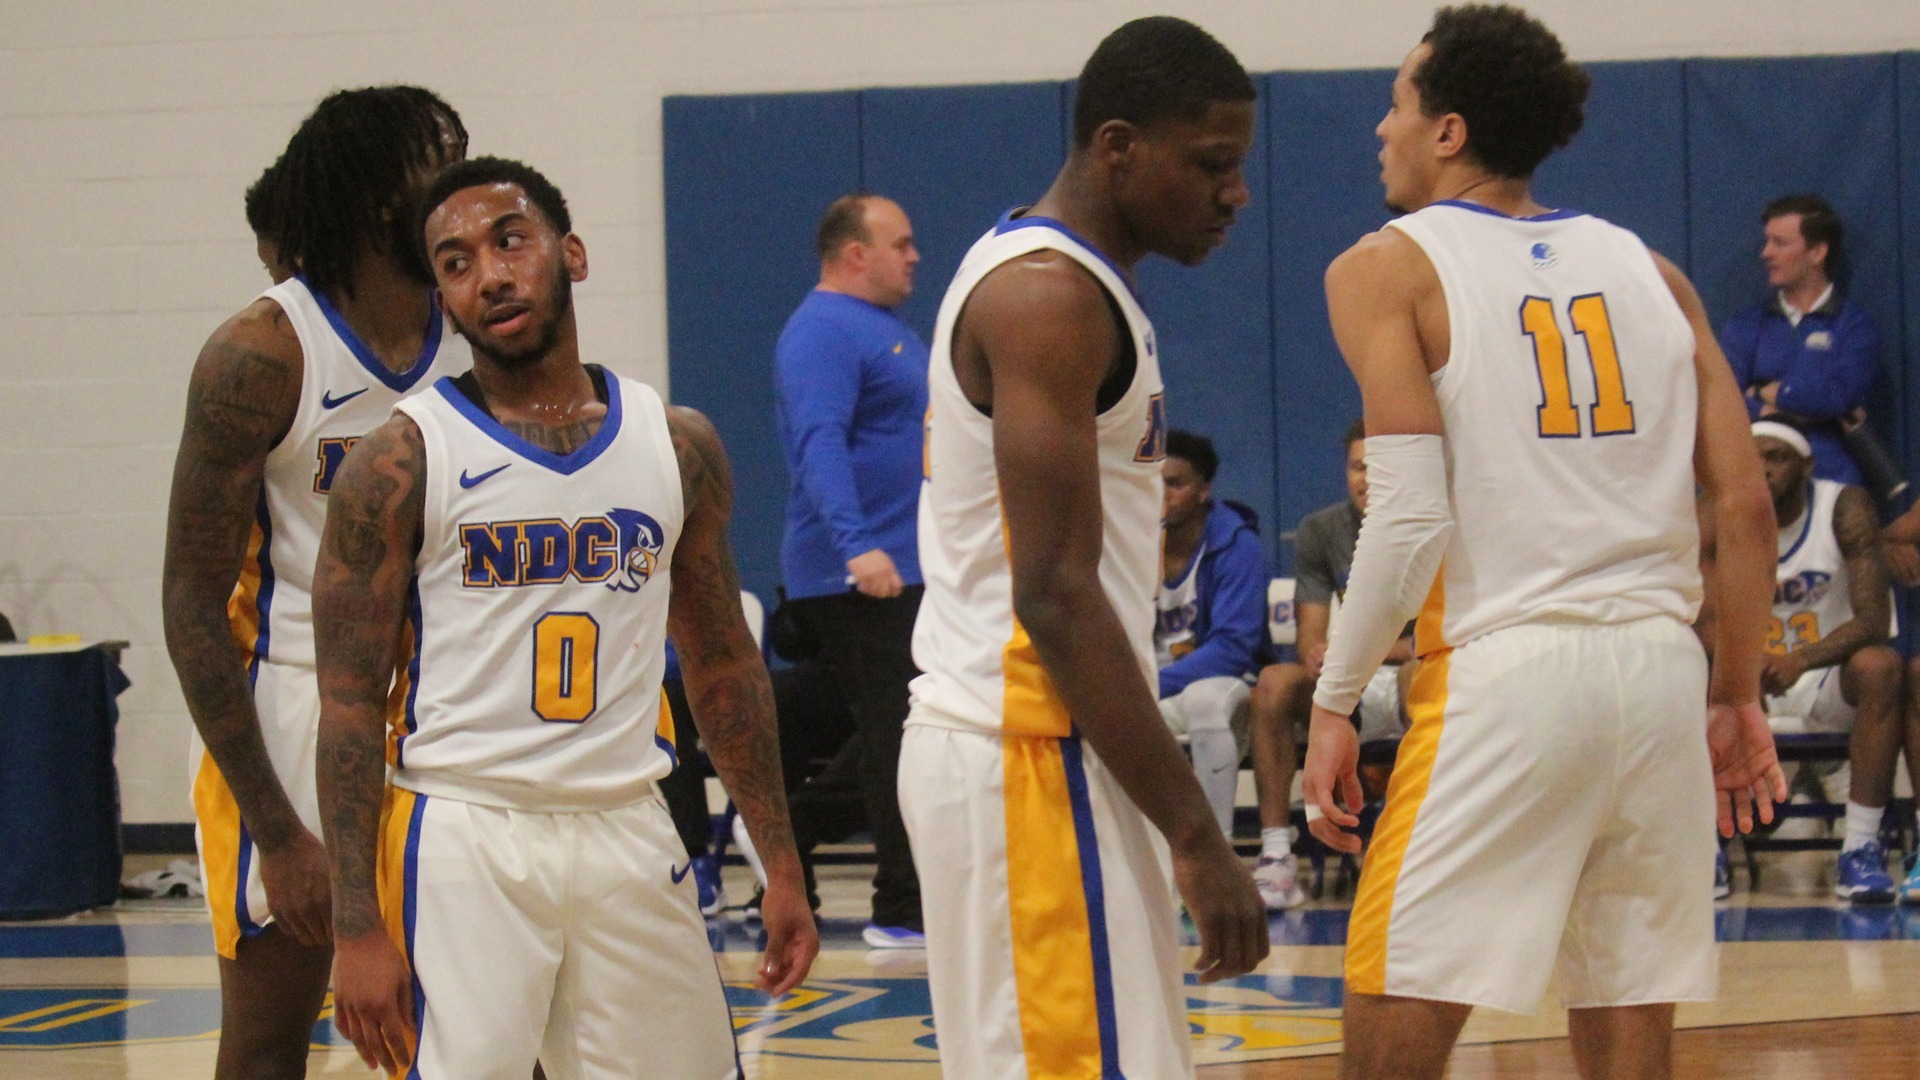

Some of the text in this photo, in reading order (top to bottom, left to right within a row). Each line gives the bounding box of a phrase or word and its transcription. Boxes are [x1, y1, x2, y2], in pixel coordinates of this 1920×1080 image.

[1518, 291, 1636, 439] 11
[459, 516, 618, 588] NDC
[531, 611, 600, 724] 0
